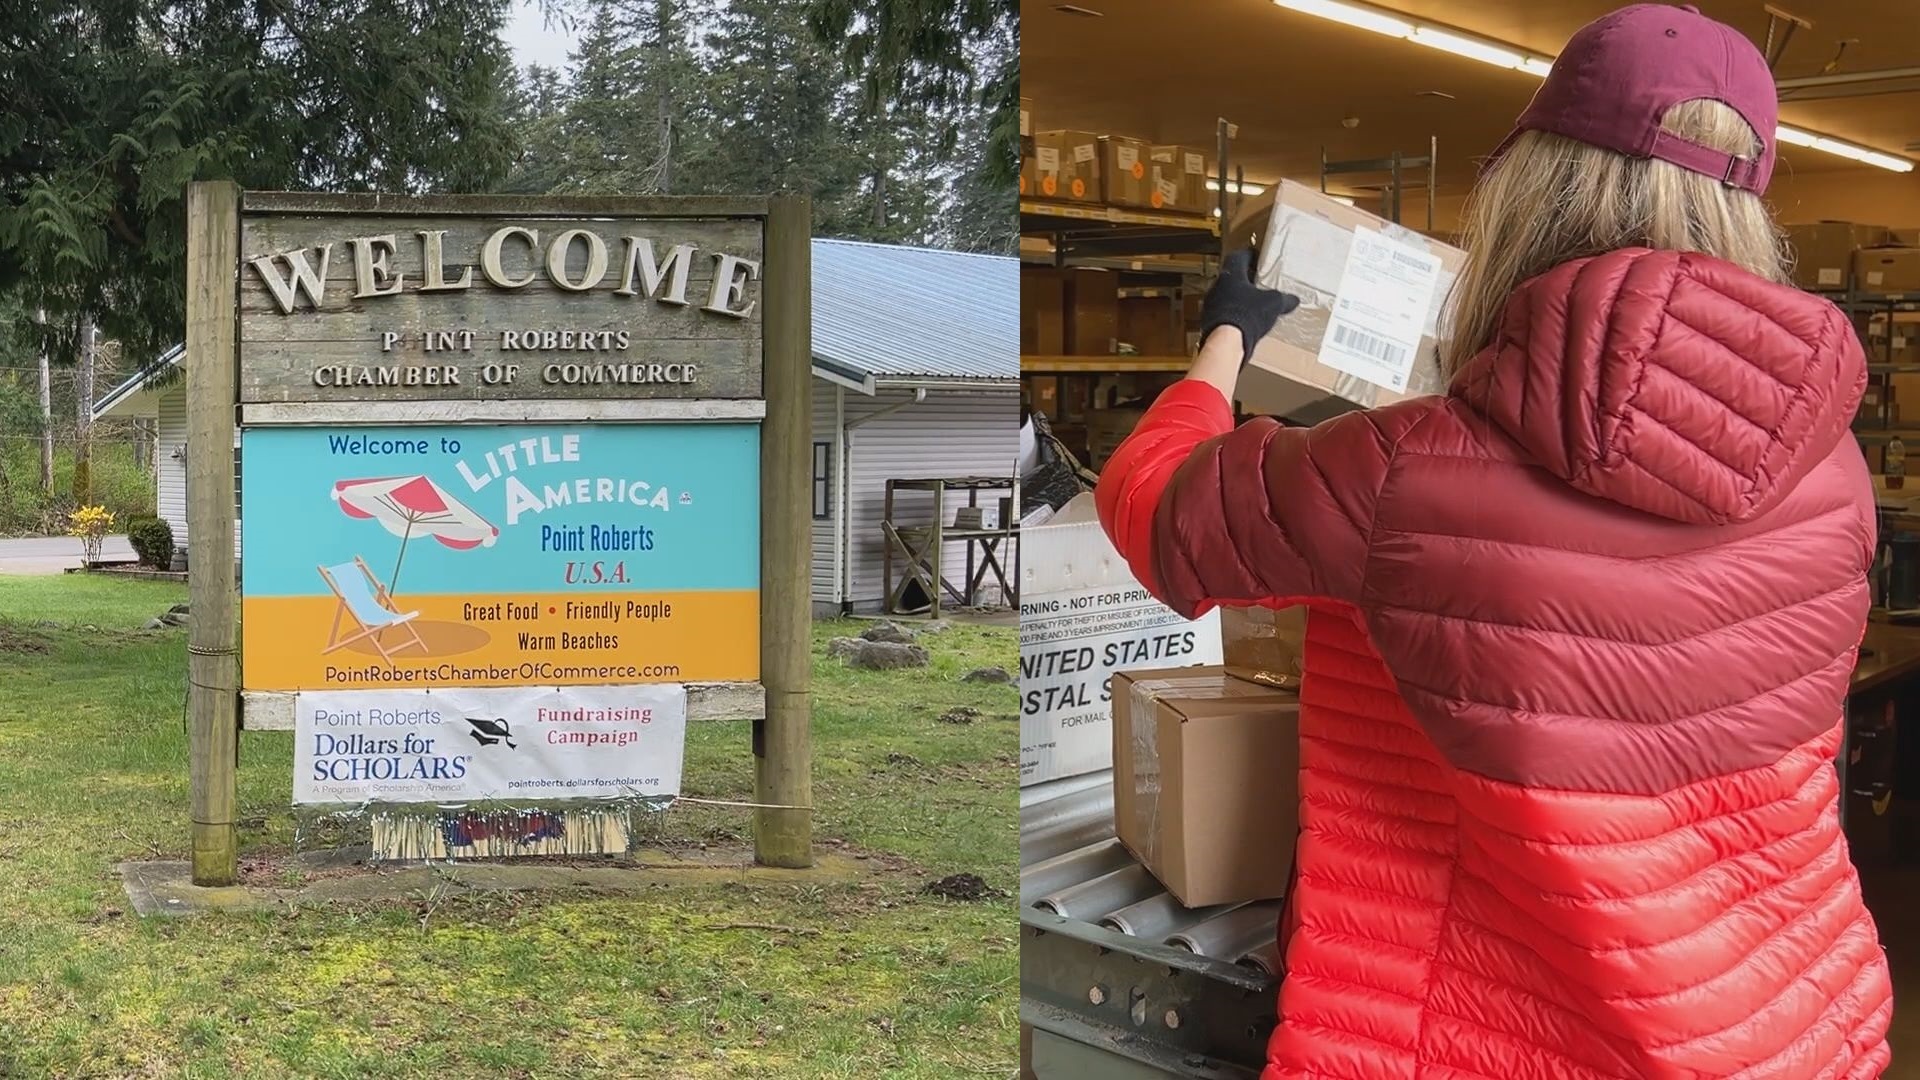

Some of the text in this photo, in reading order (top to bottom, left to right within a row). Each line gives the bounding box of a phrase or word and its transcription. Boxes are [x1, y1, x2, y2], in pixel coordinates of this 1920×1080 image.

[248, 225, 761, 320] WELCOME
[499, 330, 631, 351] ROBERTS
[313, 363, 698, 387] CHAMBER OF COMMERCE
[329, 434, 461, 455] Welcome to
[455, 434, 580, 493] LITTLE
[505, 476, 671, 525] AMERICA
[541, 524, 654, 552] Point Roberts
[564, 561, 632, 585] U.S.A.
[463, 600, 671, 623] Great Food Friendly People
[1070, 596, 1094, 609] NOT
[1097, 592, 1121, 606] FOR
[1026, 620, 1057, 632] PENALTY
[1058, 618, 1073, 627] FOR
[1074, 615, 1095, 625] THEFT
[1096, 613, 1107, 621] OR
[1108, 610, 1132, 620] MISUSE
[1133, 608, 1143, 616] OF
[1031, 632, 1048, 642] FINE
[1048, 630, 1063, 640] AND
[1069, 627, 1092, 637] YEARS
[1093, 620, 1143, 633] IMPRISONMENT
[518, 631, 619, 651] Warm Beaches
[1103, 631, 1196, 667] STATES
[325, 662, 680, 684] PointRobertsChamberOfCommerce.com
[1020, 682, 1092, 716] STAL
[315, 708, 441, 726] Point Roberts
[537, 706, 652, 723] Fundraising
[1061, 711, 1107, 729] FOR MAIL
[314, 733, 435, 757] Dollars for
[547, 729, 638, 748] Campaign
[312, 785, 320, 793] A
[322, 785, 360, 794] Program
[362, 784, 371, 793] of
[372, 783, 424, 794] Scholarship
[507, 776, 660, 789] pointroberts.dollarsforscholars.org
